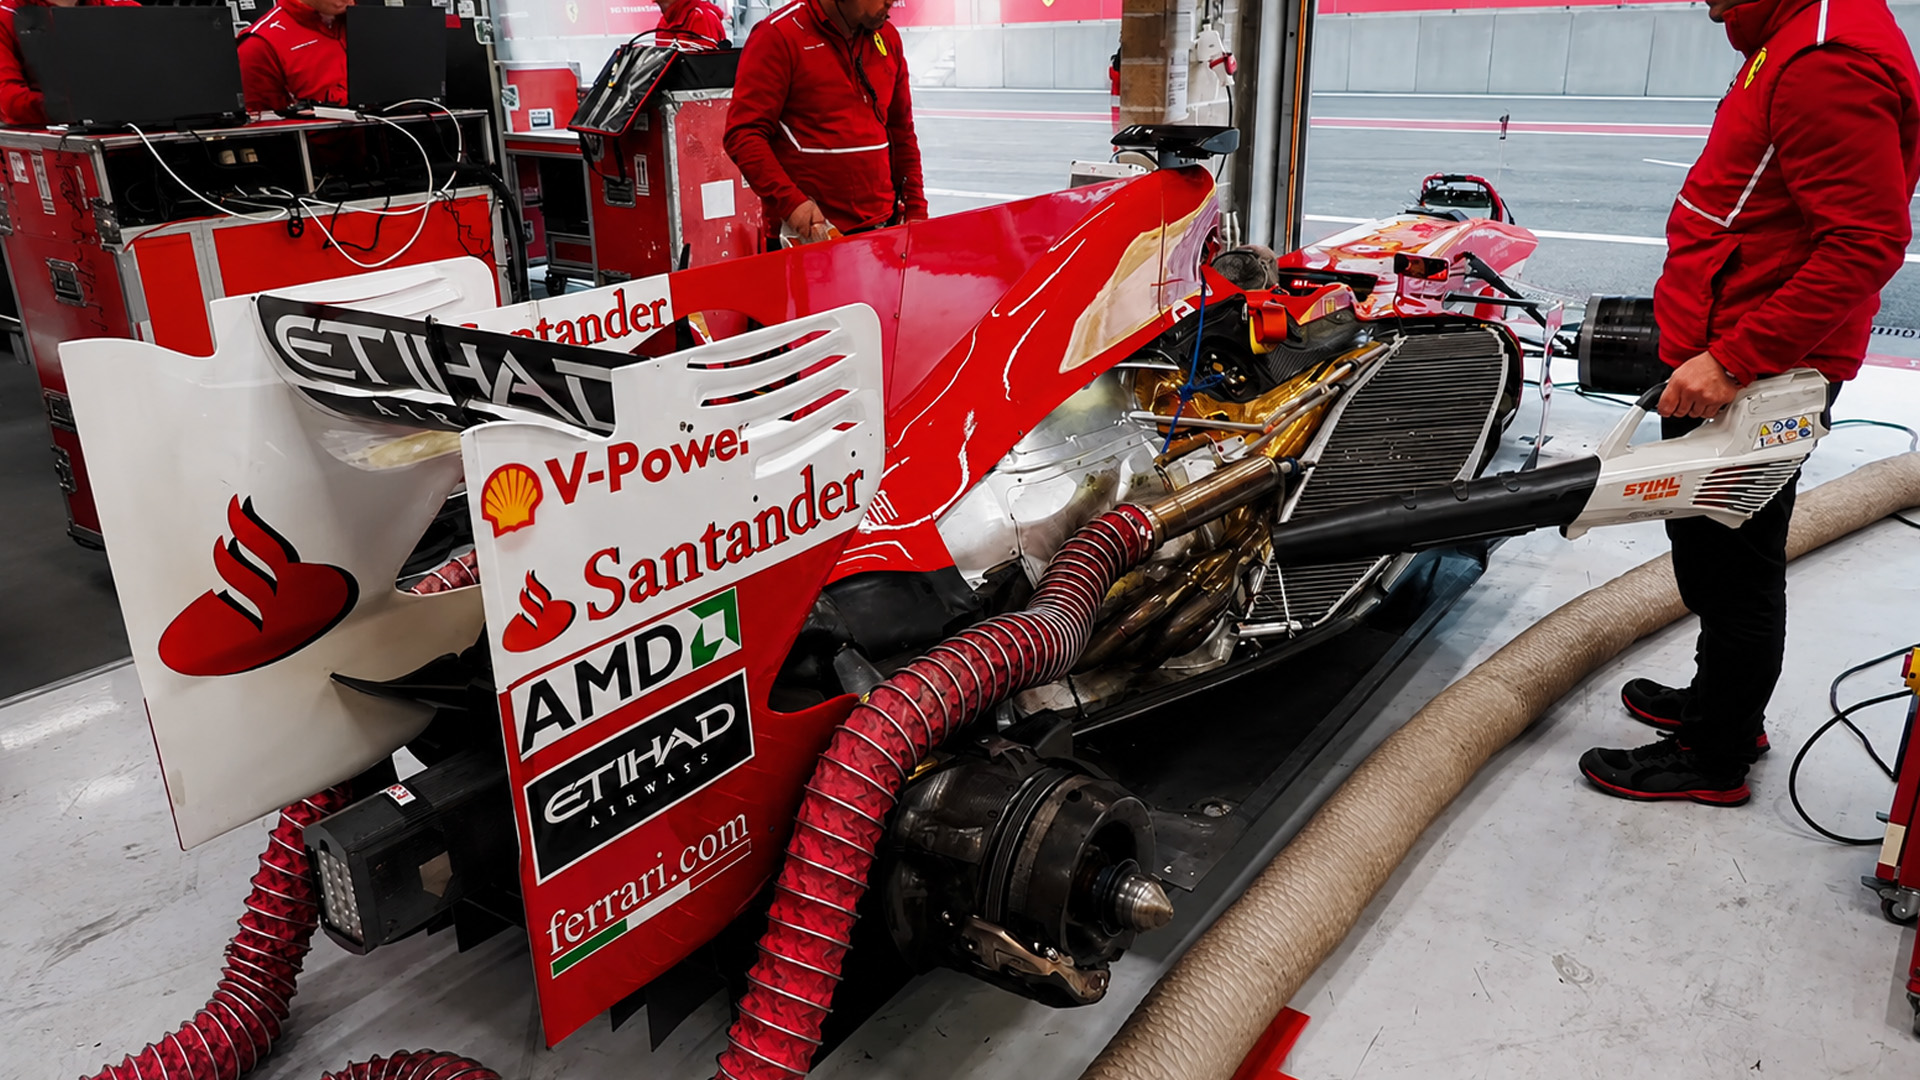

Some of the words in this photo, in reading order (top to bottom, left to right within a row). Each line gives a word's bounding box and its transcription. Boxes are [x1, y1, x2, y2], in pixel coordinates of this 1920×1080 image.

[545, 423, 749, 505] V-Power
[1622, 476, 1681, 497] STIHL
[584, 464, 864, 622] Santander
[519, 624, 683, 757] AMD
[544, 702, 737, 824] ETIHAD
[545, 813, 750, 957] ferrari.com
